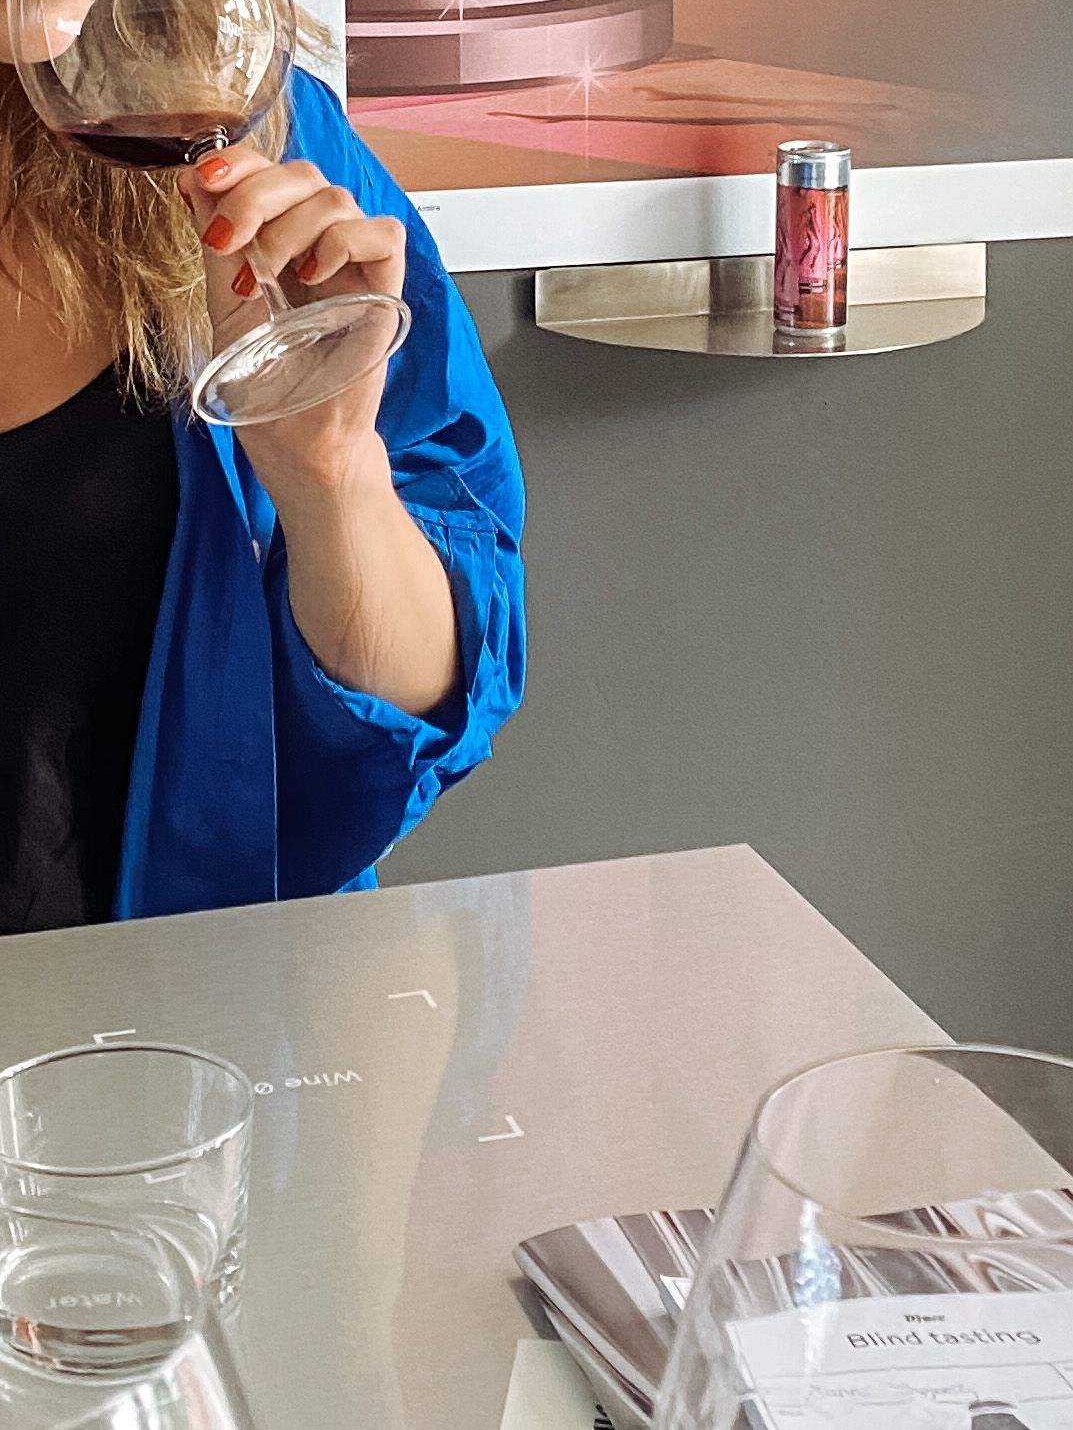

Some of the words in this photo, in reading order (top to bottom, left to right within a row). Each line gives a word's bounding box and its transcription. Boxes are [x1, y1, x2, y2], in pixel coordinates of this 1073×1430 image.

[284, 1069, 364, 1089] Wine
[44, 1291, 145, 1311] Water
[845, 1331, 924, 1350] Blind
[928, 1327, 1043, 1347] tasting
